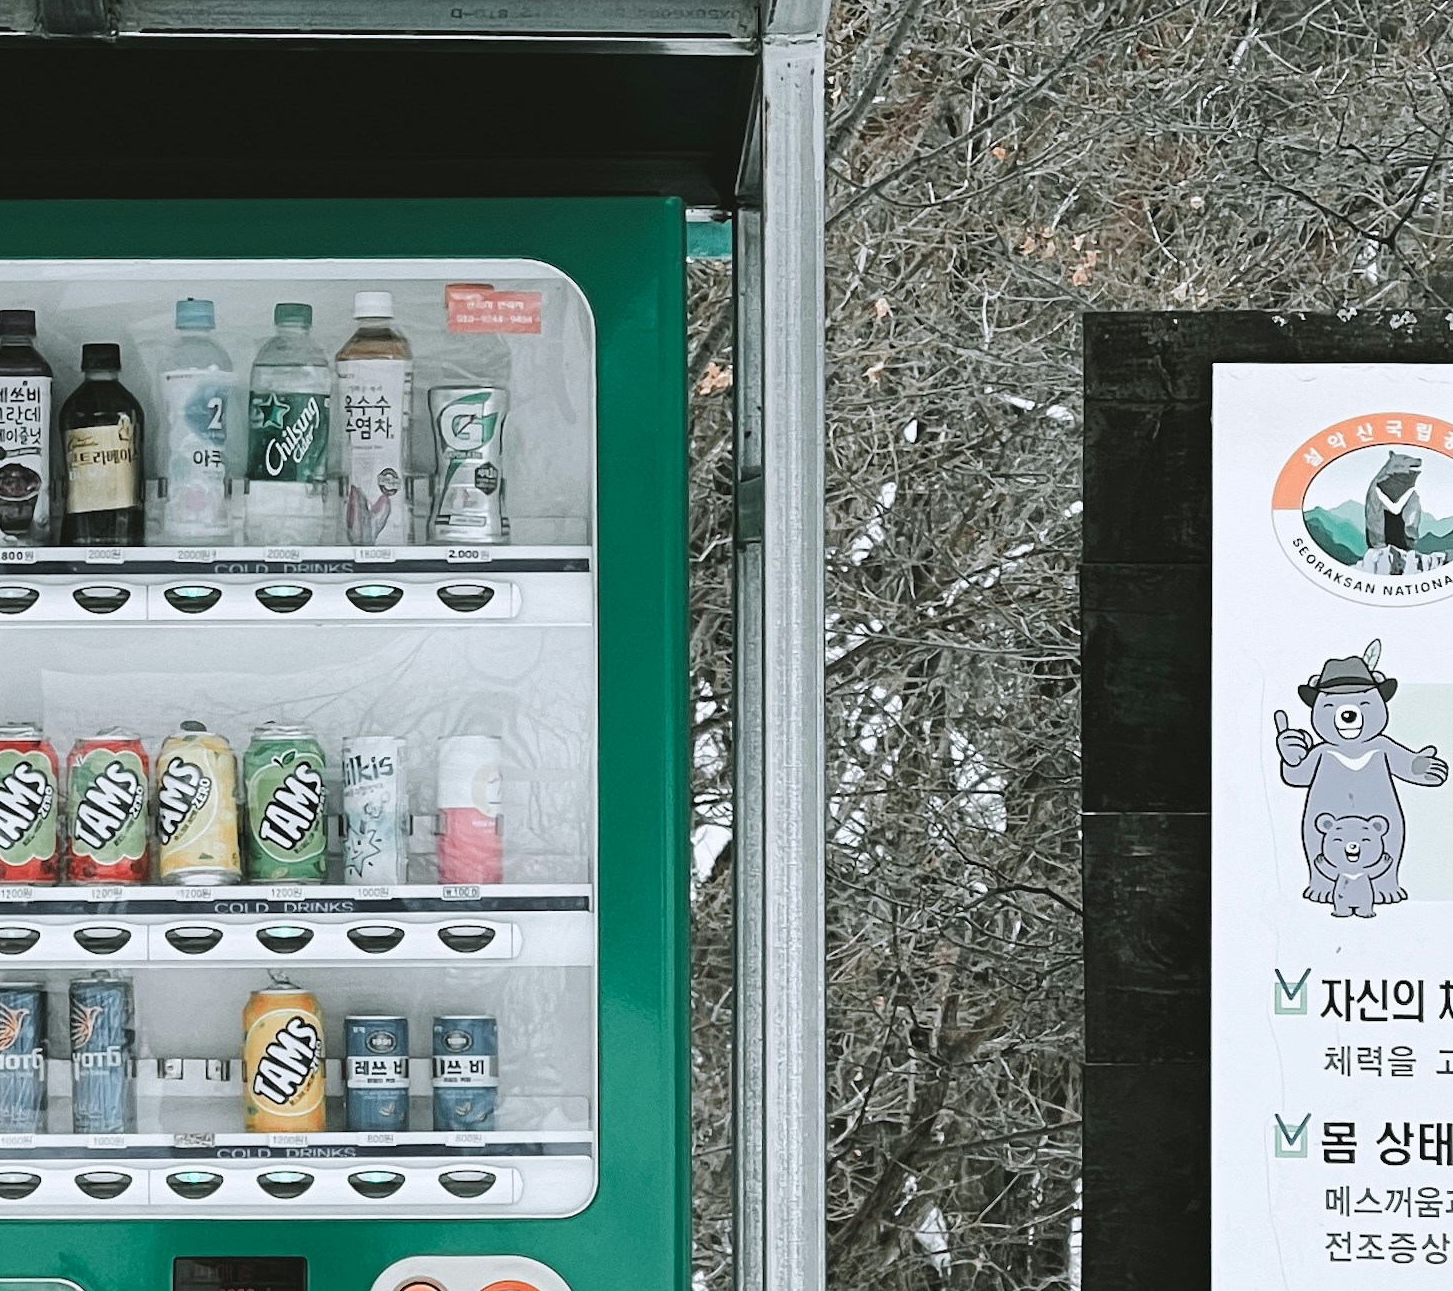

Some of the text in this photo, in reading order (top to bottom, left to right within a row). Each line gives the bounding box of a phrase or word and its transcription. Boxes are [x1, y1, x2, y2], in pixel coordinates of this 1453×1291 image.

[265, 395, 321, 477] Chilsung
[1292, 537, 1376, 595] SEORAKSAN
[159, 756, 213, 845] AMS ZERO
[342, 755, 395, 788] ilkis
[74, 760, 140, 851] TAMS
[259, 760, 323, 851] TAMS
[1320, 978, 1425, 1023] 자신의
[253, 1015, 319, 1105] TAMS
[1323, 1044, 1417, 1078] 체력을
[1321, 1121, 1358, 1165] 몸
[1324, 1230, 1451, 1265] 전조증상
